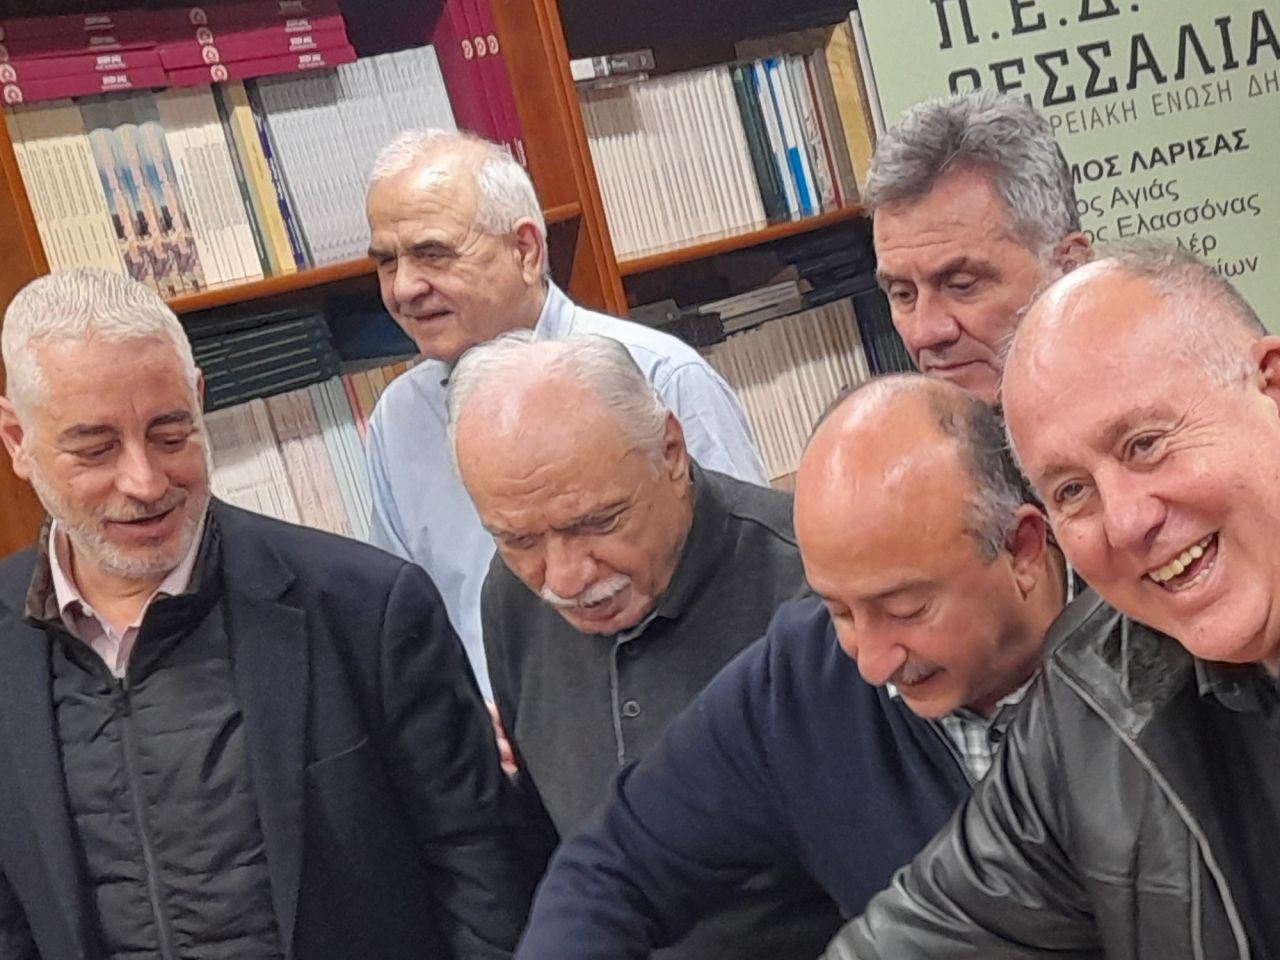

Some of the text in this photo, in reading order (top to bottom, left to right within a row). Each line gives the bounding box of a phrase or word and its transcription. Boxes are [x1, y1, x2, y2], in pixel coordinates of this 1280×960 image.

[1050, 99, 1137, 137] ΡΕΙΑΚΗ
[1152, 79, 1233, 117] ΕΝΩΣΗ
[1130, 128, 1249, 173] ΛΑΡΙΣΑΣ
[1110, 178, 1180, 209] Αγιάς
[1117, 194, 1262, 238] Ελασσόνας
